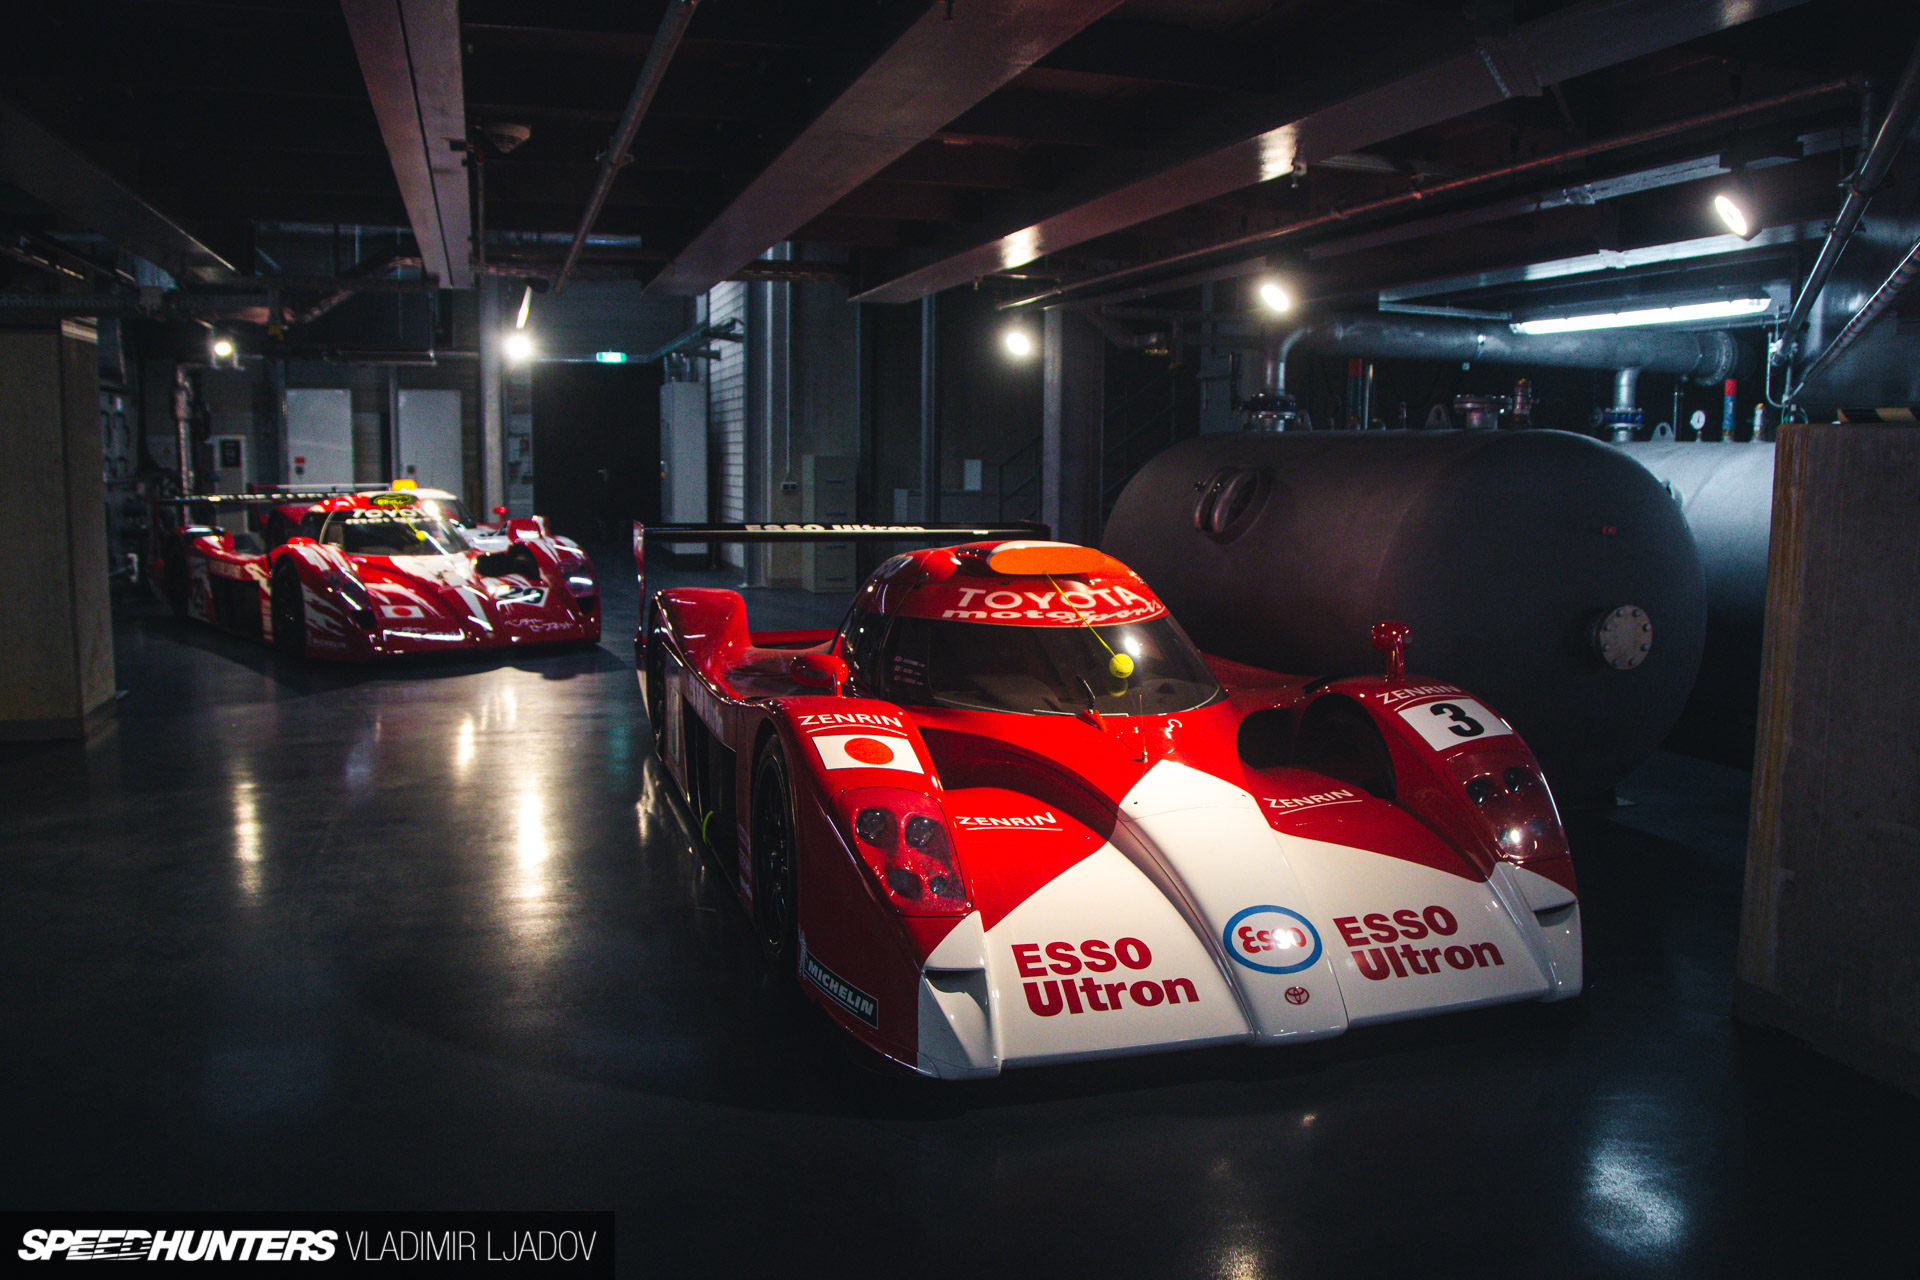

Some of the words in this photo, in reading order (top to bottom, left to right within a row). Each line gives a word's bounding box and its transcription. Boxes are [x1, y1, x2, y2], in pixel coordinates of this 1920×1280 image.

[957, 586, 1148, 610] TOYOTA
[1375, 685, 1462, 705] ZENRIN
[798, 713, 903, 728] ZENRIN
[1430, 703, 1485, 737] 3
[1263, 788, 1355, 809] ZENRIN
[955, 811, 1057, 827] ZENRIN
[1333, 905, 1458, 946] ESSO
[1011, 937, 1152, 977] ESSO
[1351, 938, 1505, 981] Ultron
[807, 959, 874, 1016] MICHELIN
[1022, 976, 1200, 1017] Ultron
